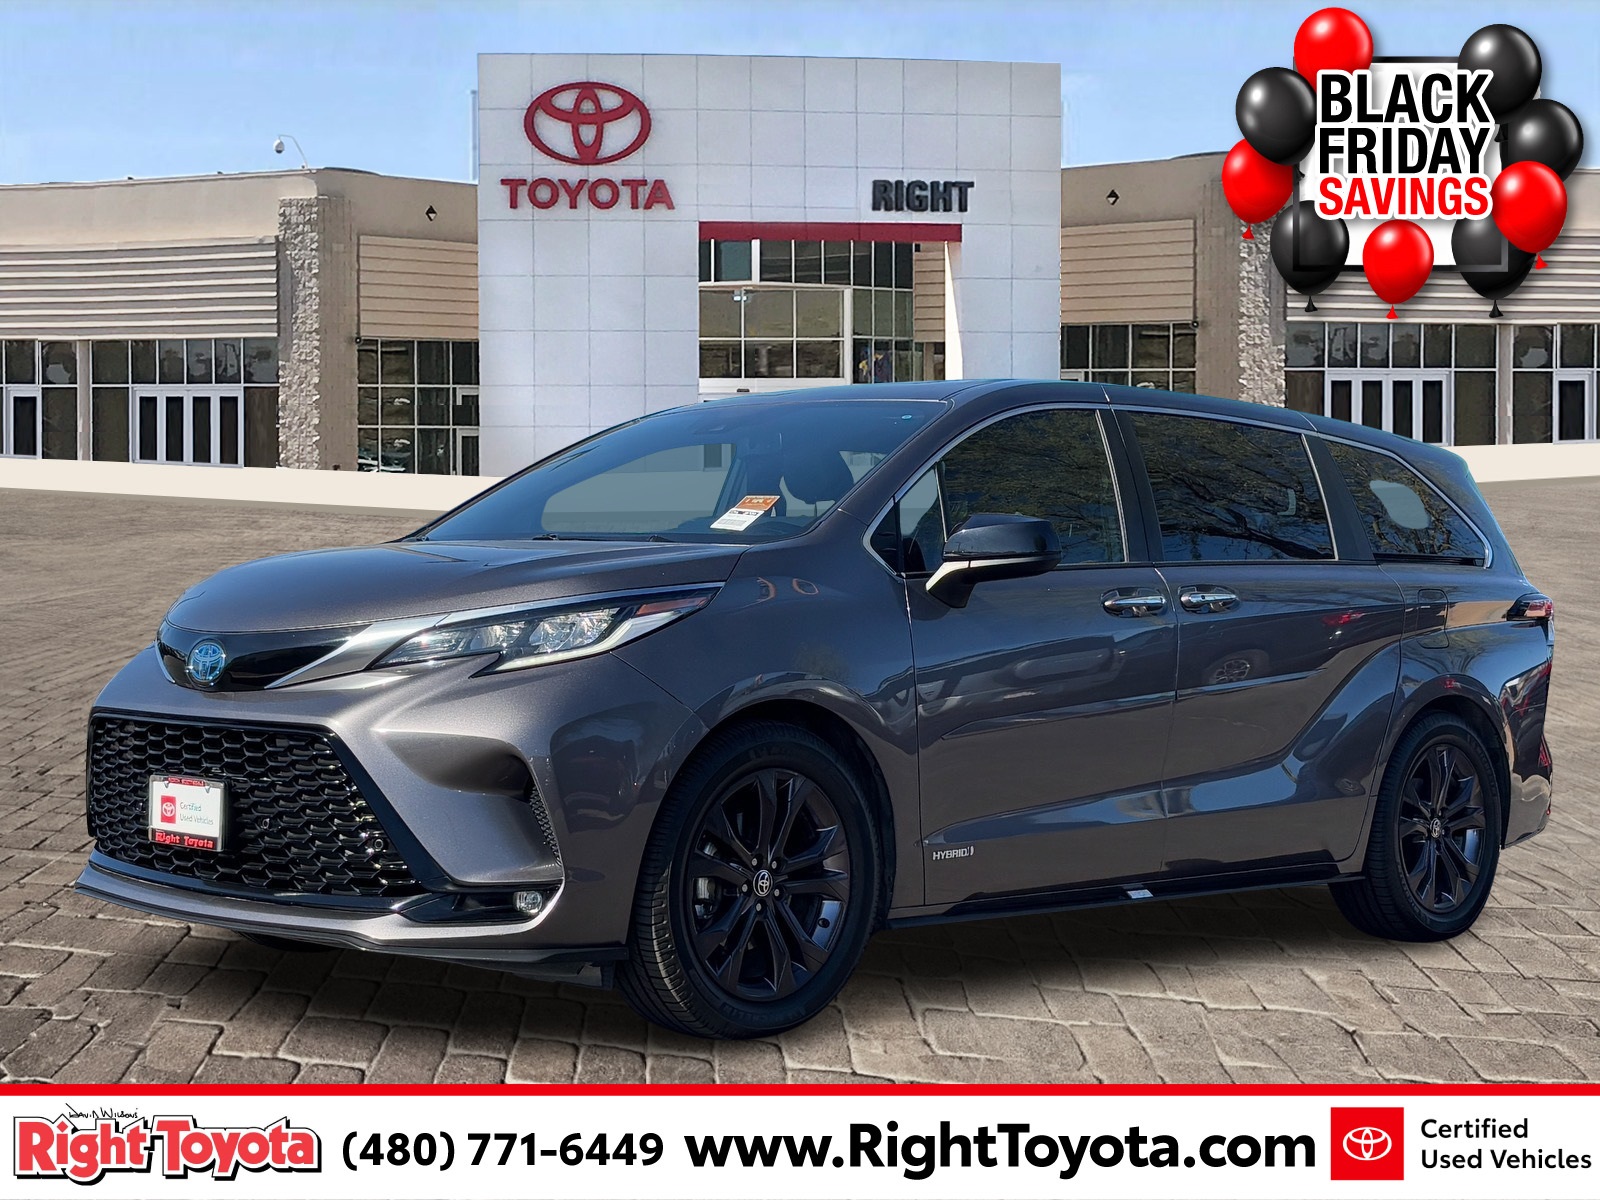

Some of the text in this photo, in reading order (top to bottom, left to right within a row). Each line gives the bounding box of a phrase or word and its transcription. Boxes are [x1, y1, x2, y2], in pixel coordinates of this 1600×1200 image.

[500, 177, 675, 210] TOYOTA
[872, 179, 975, 212] RIGHT
[932, 847, 970, 860] HYBRID
